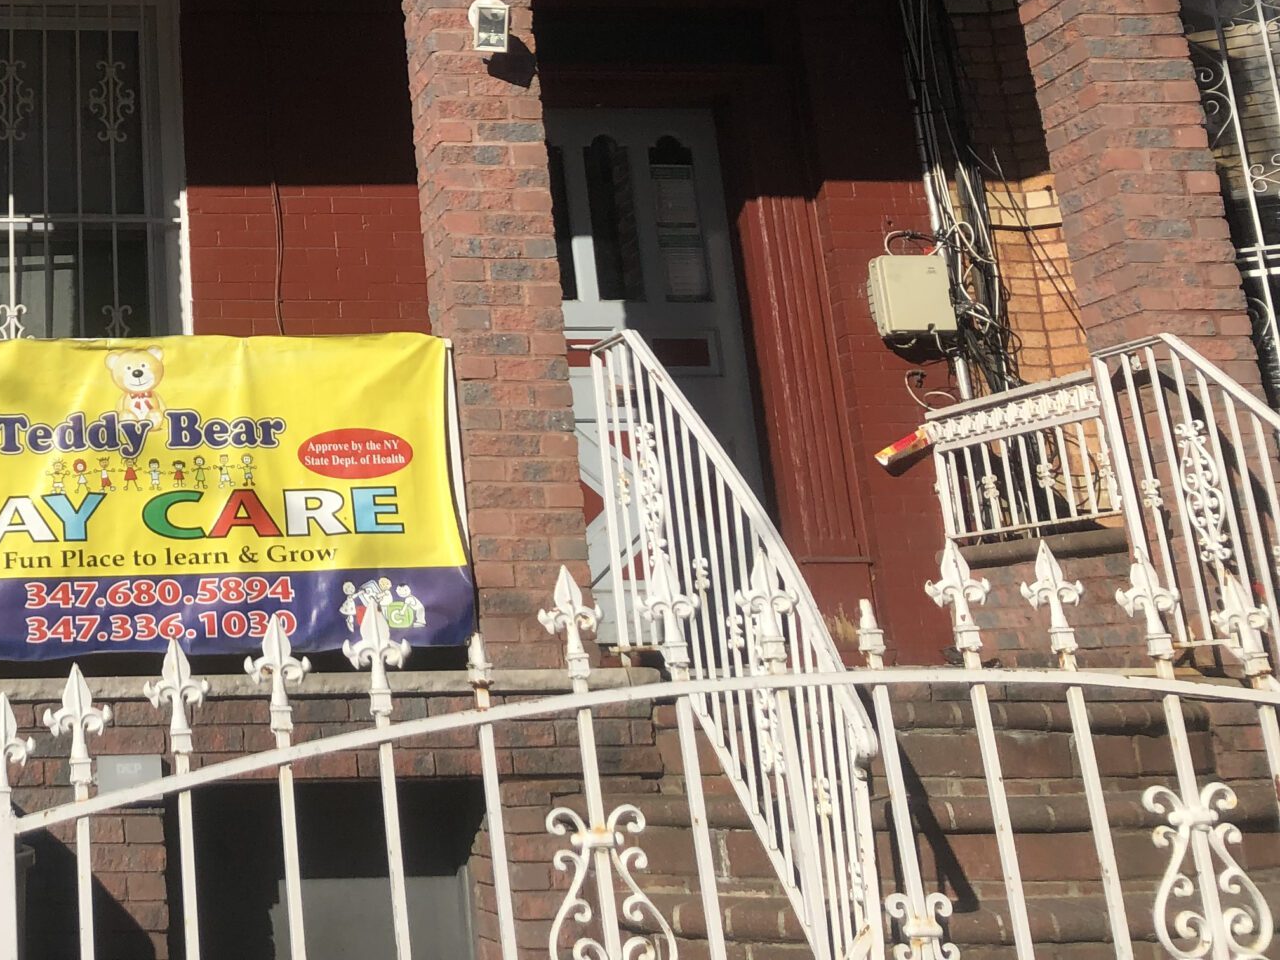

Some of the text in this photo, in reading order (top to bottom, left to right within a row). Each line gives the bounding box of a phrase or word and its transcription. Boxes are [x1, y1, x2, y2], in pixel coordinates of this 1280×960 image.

[164, 409, 286, 450] Bear
[304, 453, 405, 468] State Dept. of Health
[307, 439, 400, 454] Approve by the NY
[142, 486, 405, 540] CARE
[3, 551, 52, 569] Fun
[61, 549, 125, 568] Place
[134, 550, 157, 566] to
[165, 547, 229, 566] learn
[238, 545, 260, 563] &
[267, 545, 339, 563] Grow
[24, 576, 295, 609] 347.680.5894
[25, 609, 298, 644] 347.336.1030
